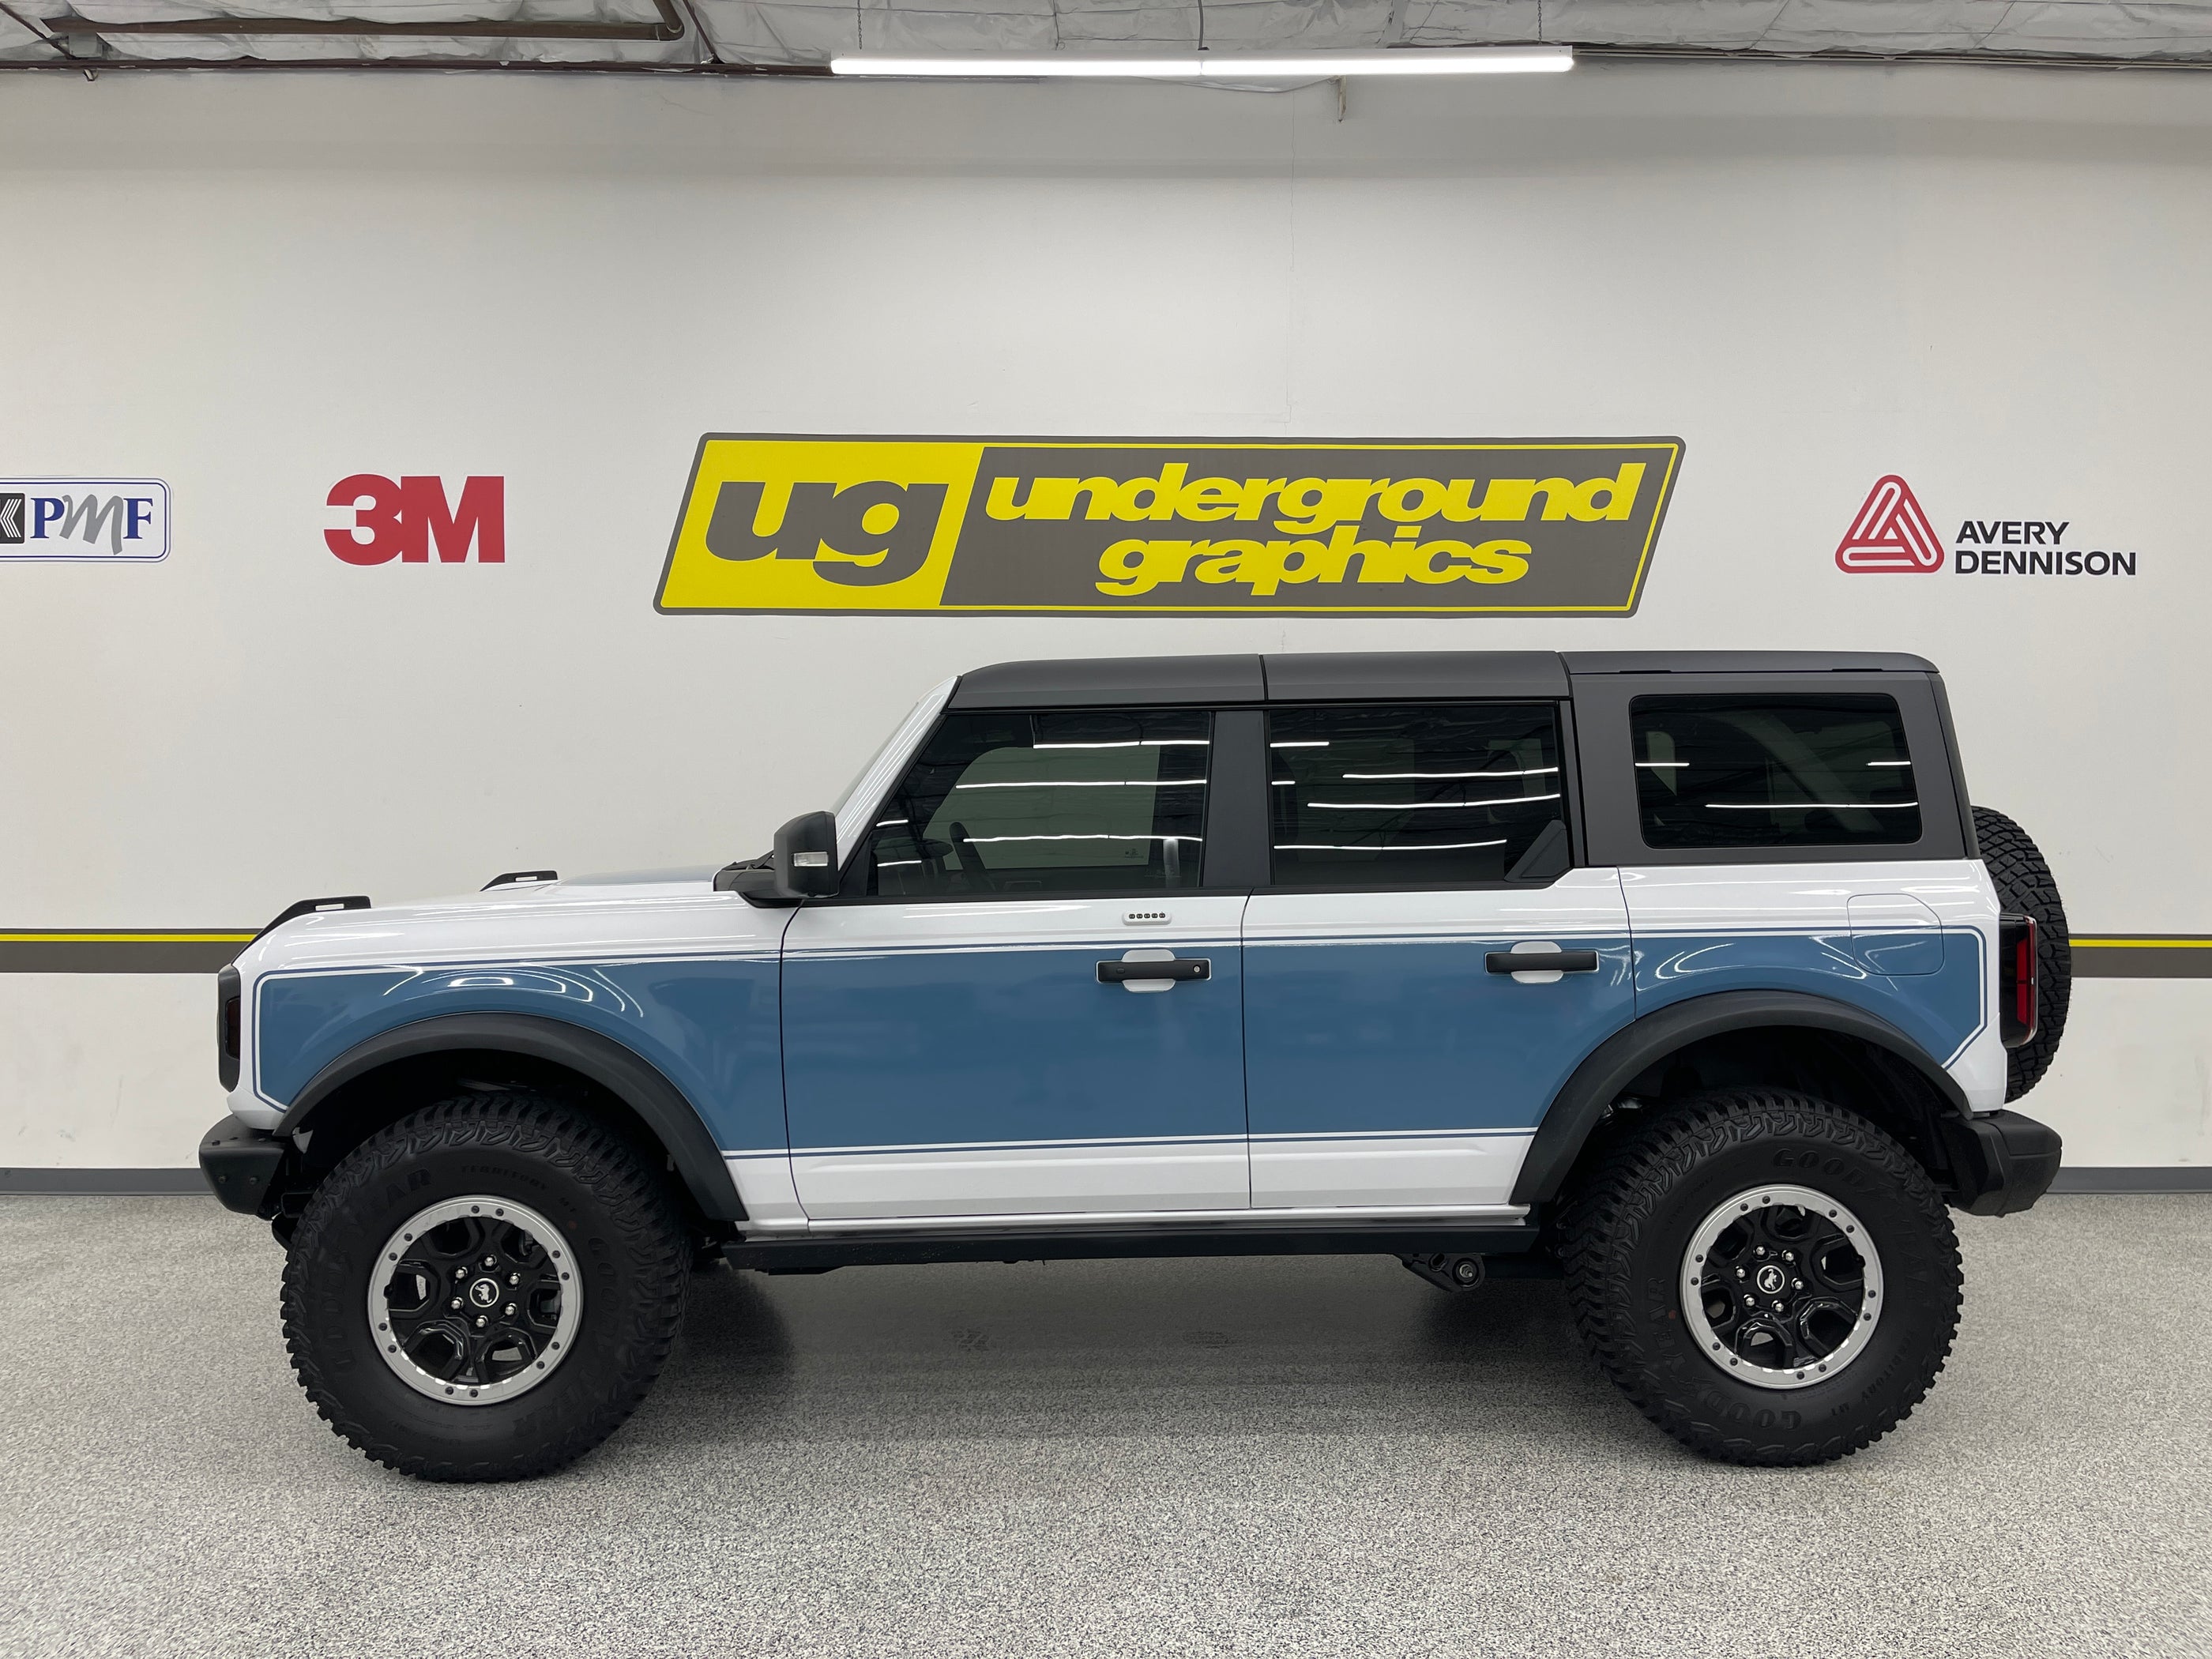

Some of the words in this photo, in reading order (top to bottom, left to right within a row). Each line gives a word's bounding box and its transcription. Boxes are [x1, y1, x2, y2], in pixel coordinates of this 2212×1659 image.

[325, 474, 506, 566] 3M
[706, 480, 949, 586] ug
[985, 462, 1646, 536] underground
[1956, 521, 2070, 545] AVERY
[1096, 525, 1533, 596] graphics
[1955, 551, 2136, 576] DENNISON
